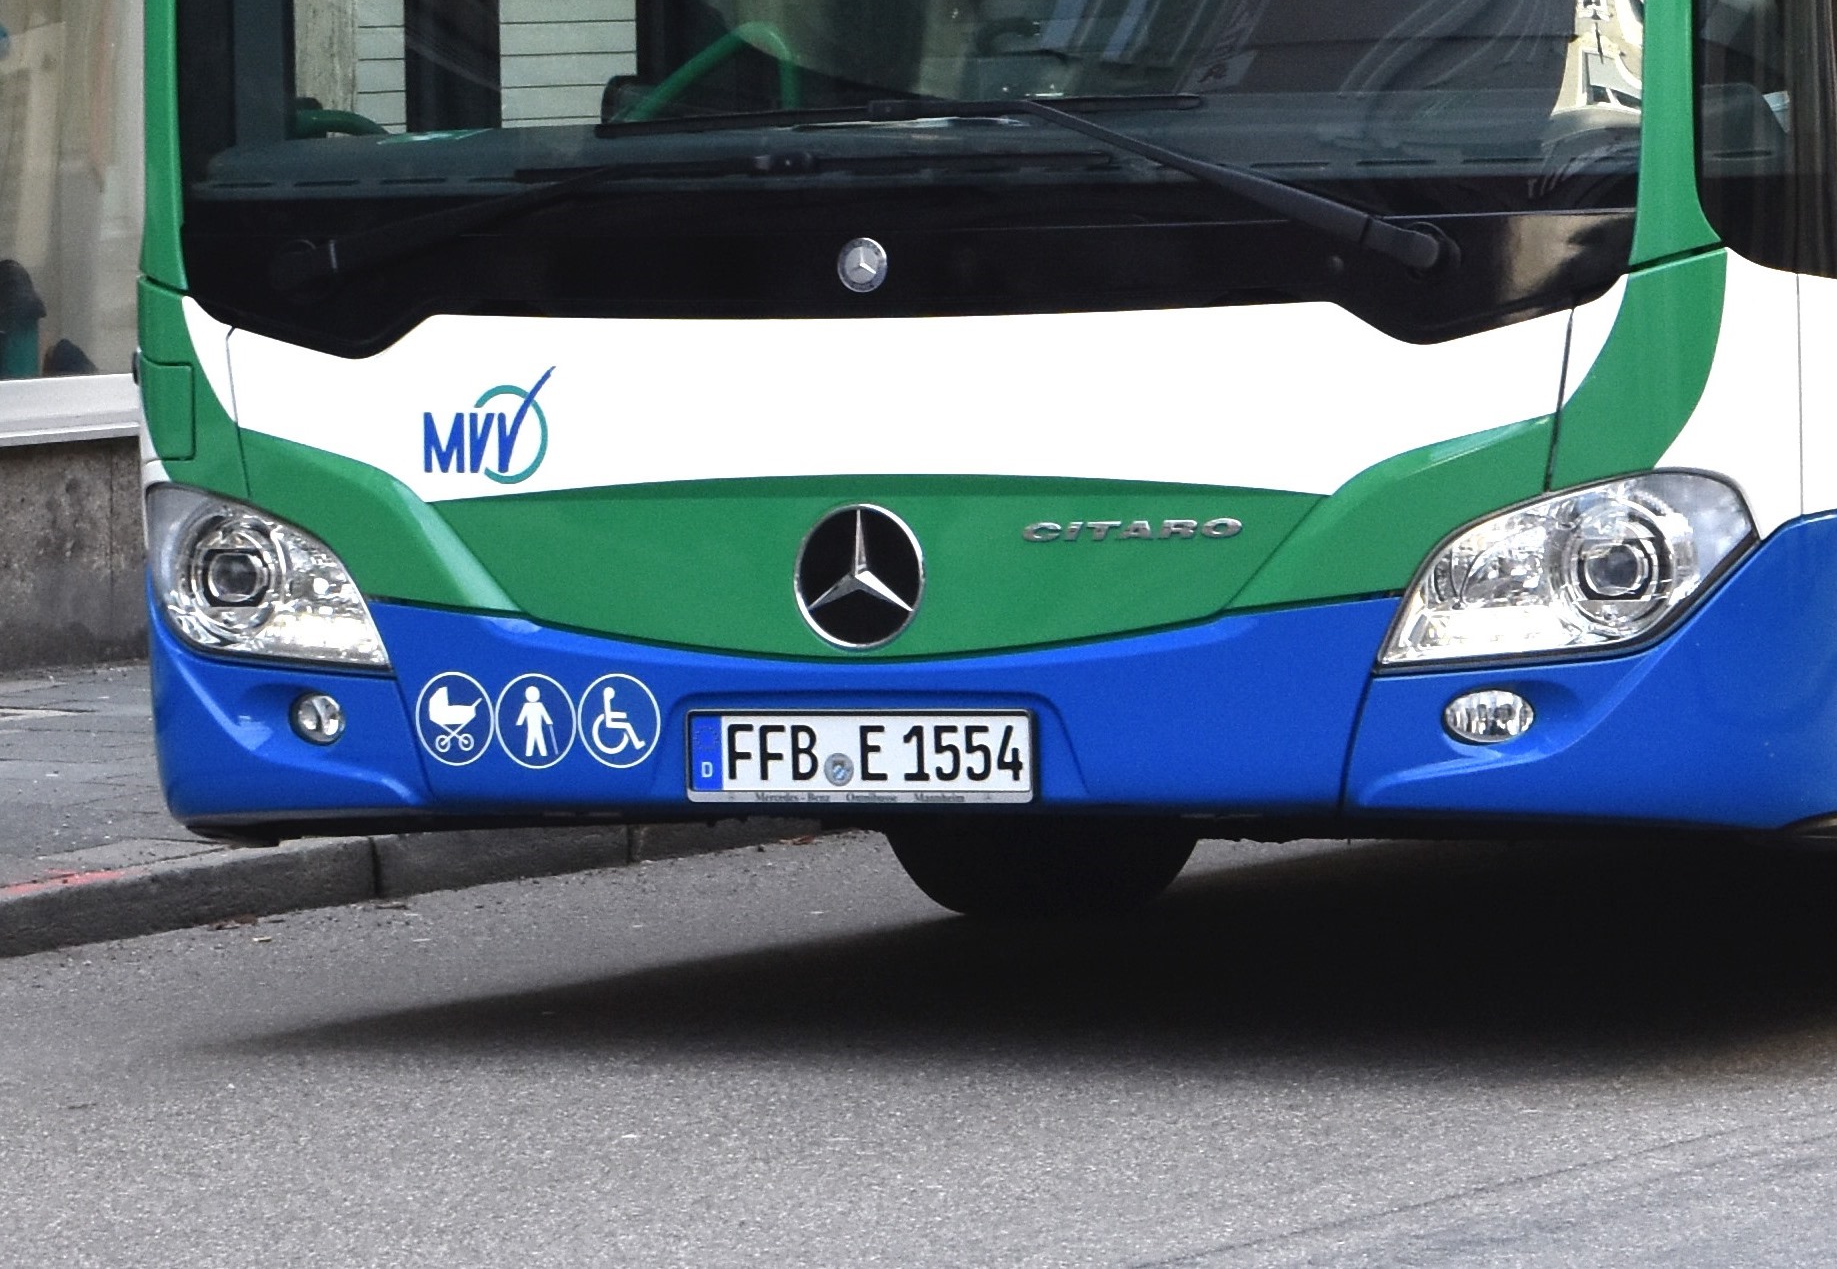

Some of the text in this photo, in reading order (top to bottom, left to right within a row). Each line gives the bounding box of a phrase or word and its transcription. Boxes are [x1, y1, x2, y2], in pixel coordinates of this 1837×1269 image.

[423, 365, 556, 474] MVV
[1022, 517, 1243, 543] CITARO
[701, 761, 714, 778] D
[727, 724, 1024, 782] FFB E 1554
